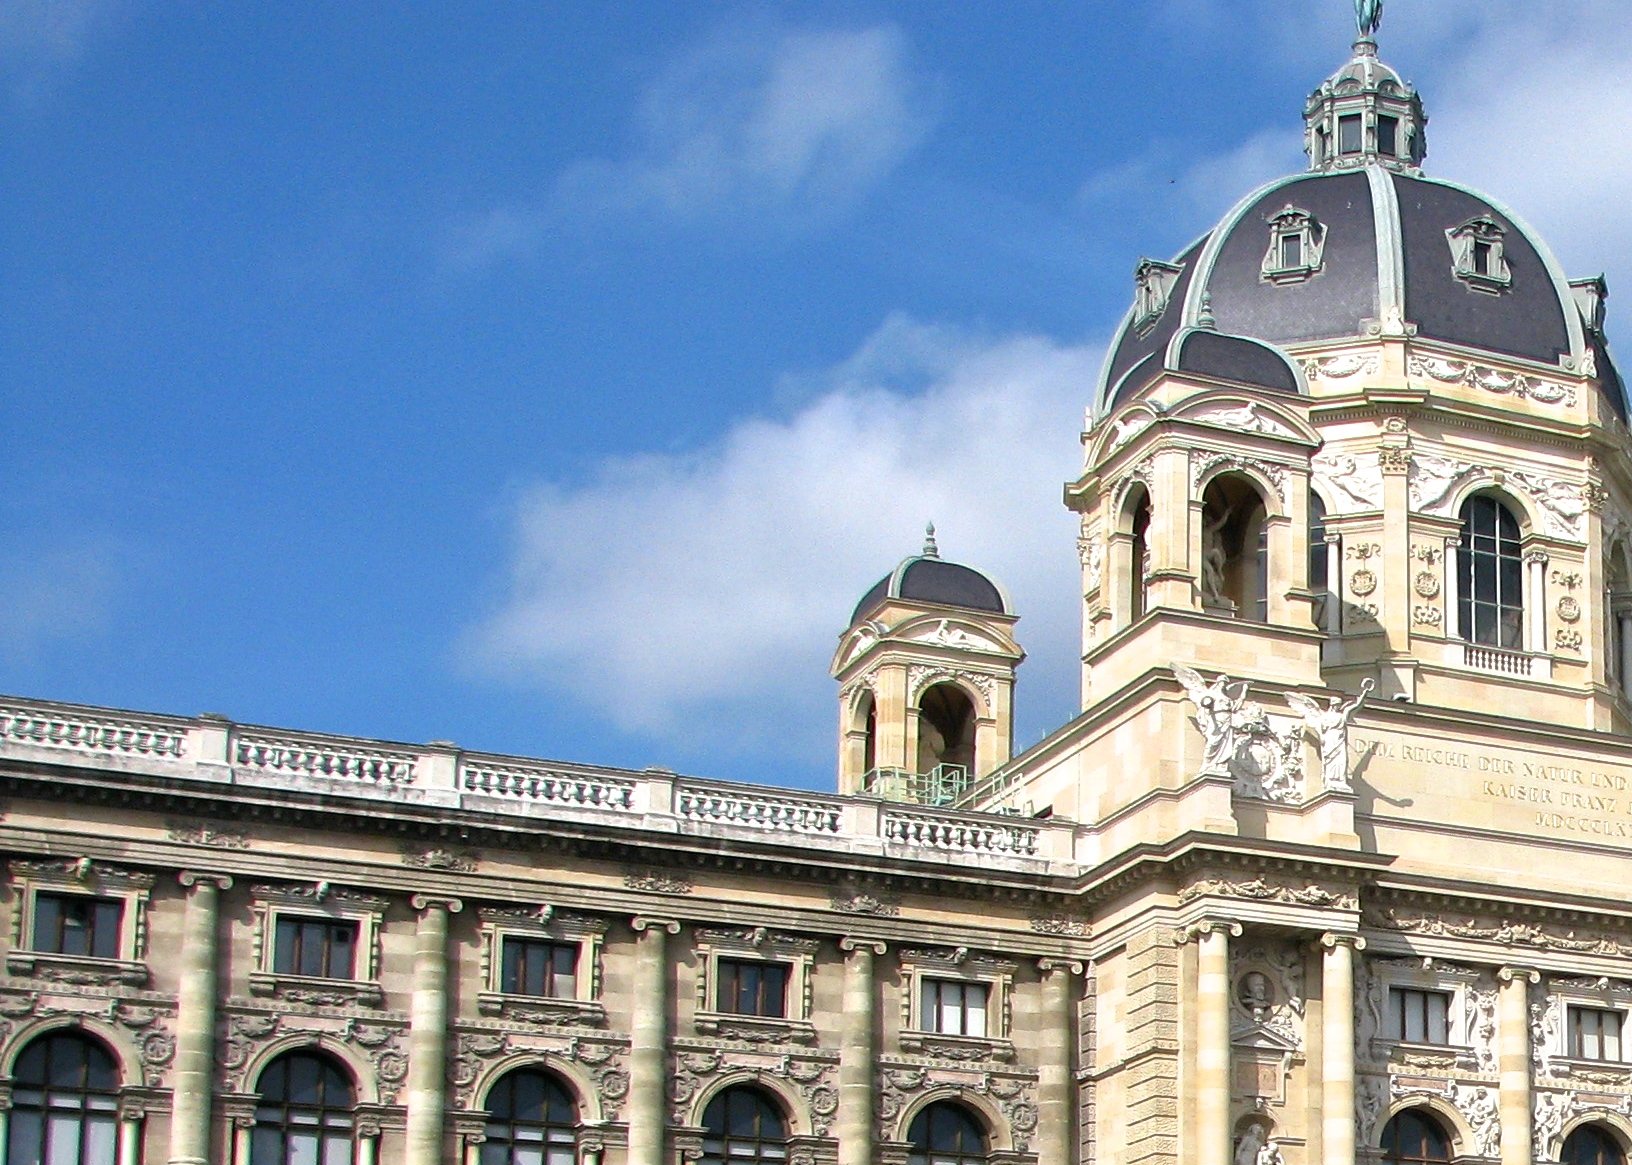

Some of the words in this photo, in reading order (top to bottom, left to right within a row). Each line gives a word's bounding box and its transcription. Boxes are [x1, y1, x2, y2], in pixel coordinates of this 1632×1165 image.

[1355, 739, 1395, 758] DEM
[1402, 745, 1470, 769] REICHE
[1478, 756, 1515, 775] DER
[1522, 762, 1584, 785] NATUR
[1591, 772, 1626, 791] UND
[1483, 781, 1553, 804] KAISER
[1561, 791, 1616, 813] FRANZ
